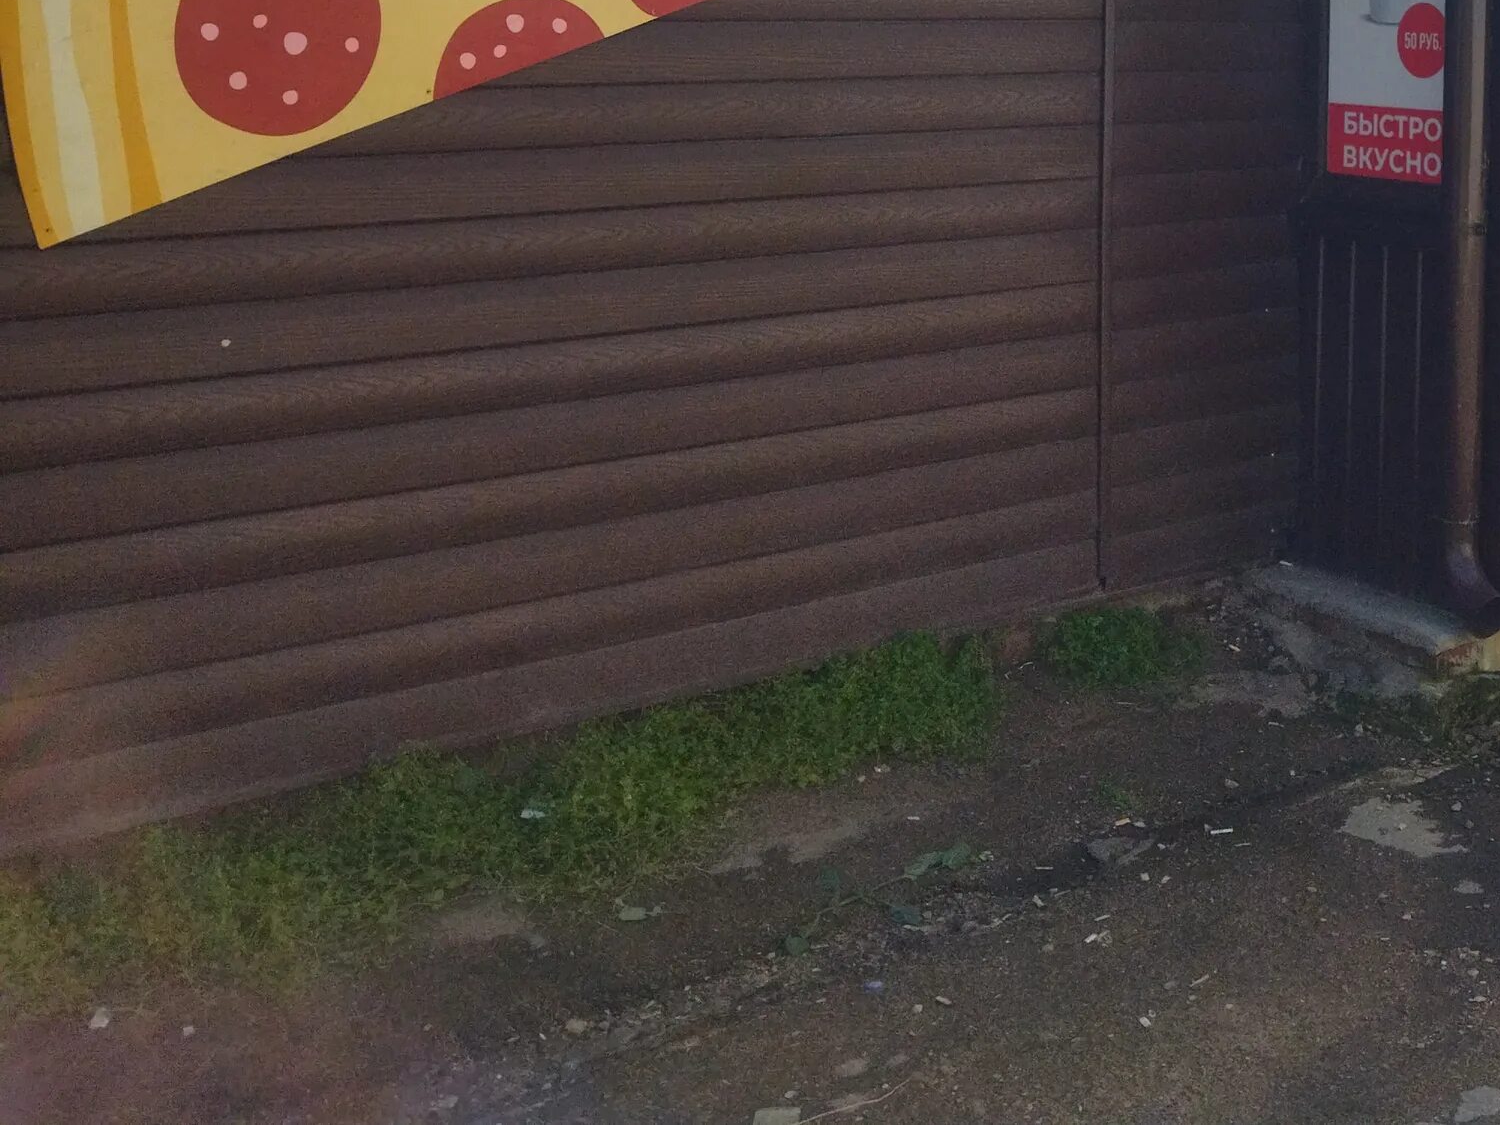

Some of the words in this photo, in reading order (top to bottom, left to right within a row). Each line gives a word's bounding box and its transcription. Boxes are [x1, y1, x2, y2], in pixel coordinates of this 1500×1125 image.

[1404, 32, 1417, 49] 50
[1419, 32, 1442, 50] РУБ.
[1342, 111, 1443, 143] БЫСТРО
[1343, 144, 1442, 177] ВКУСНО
